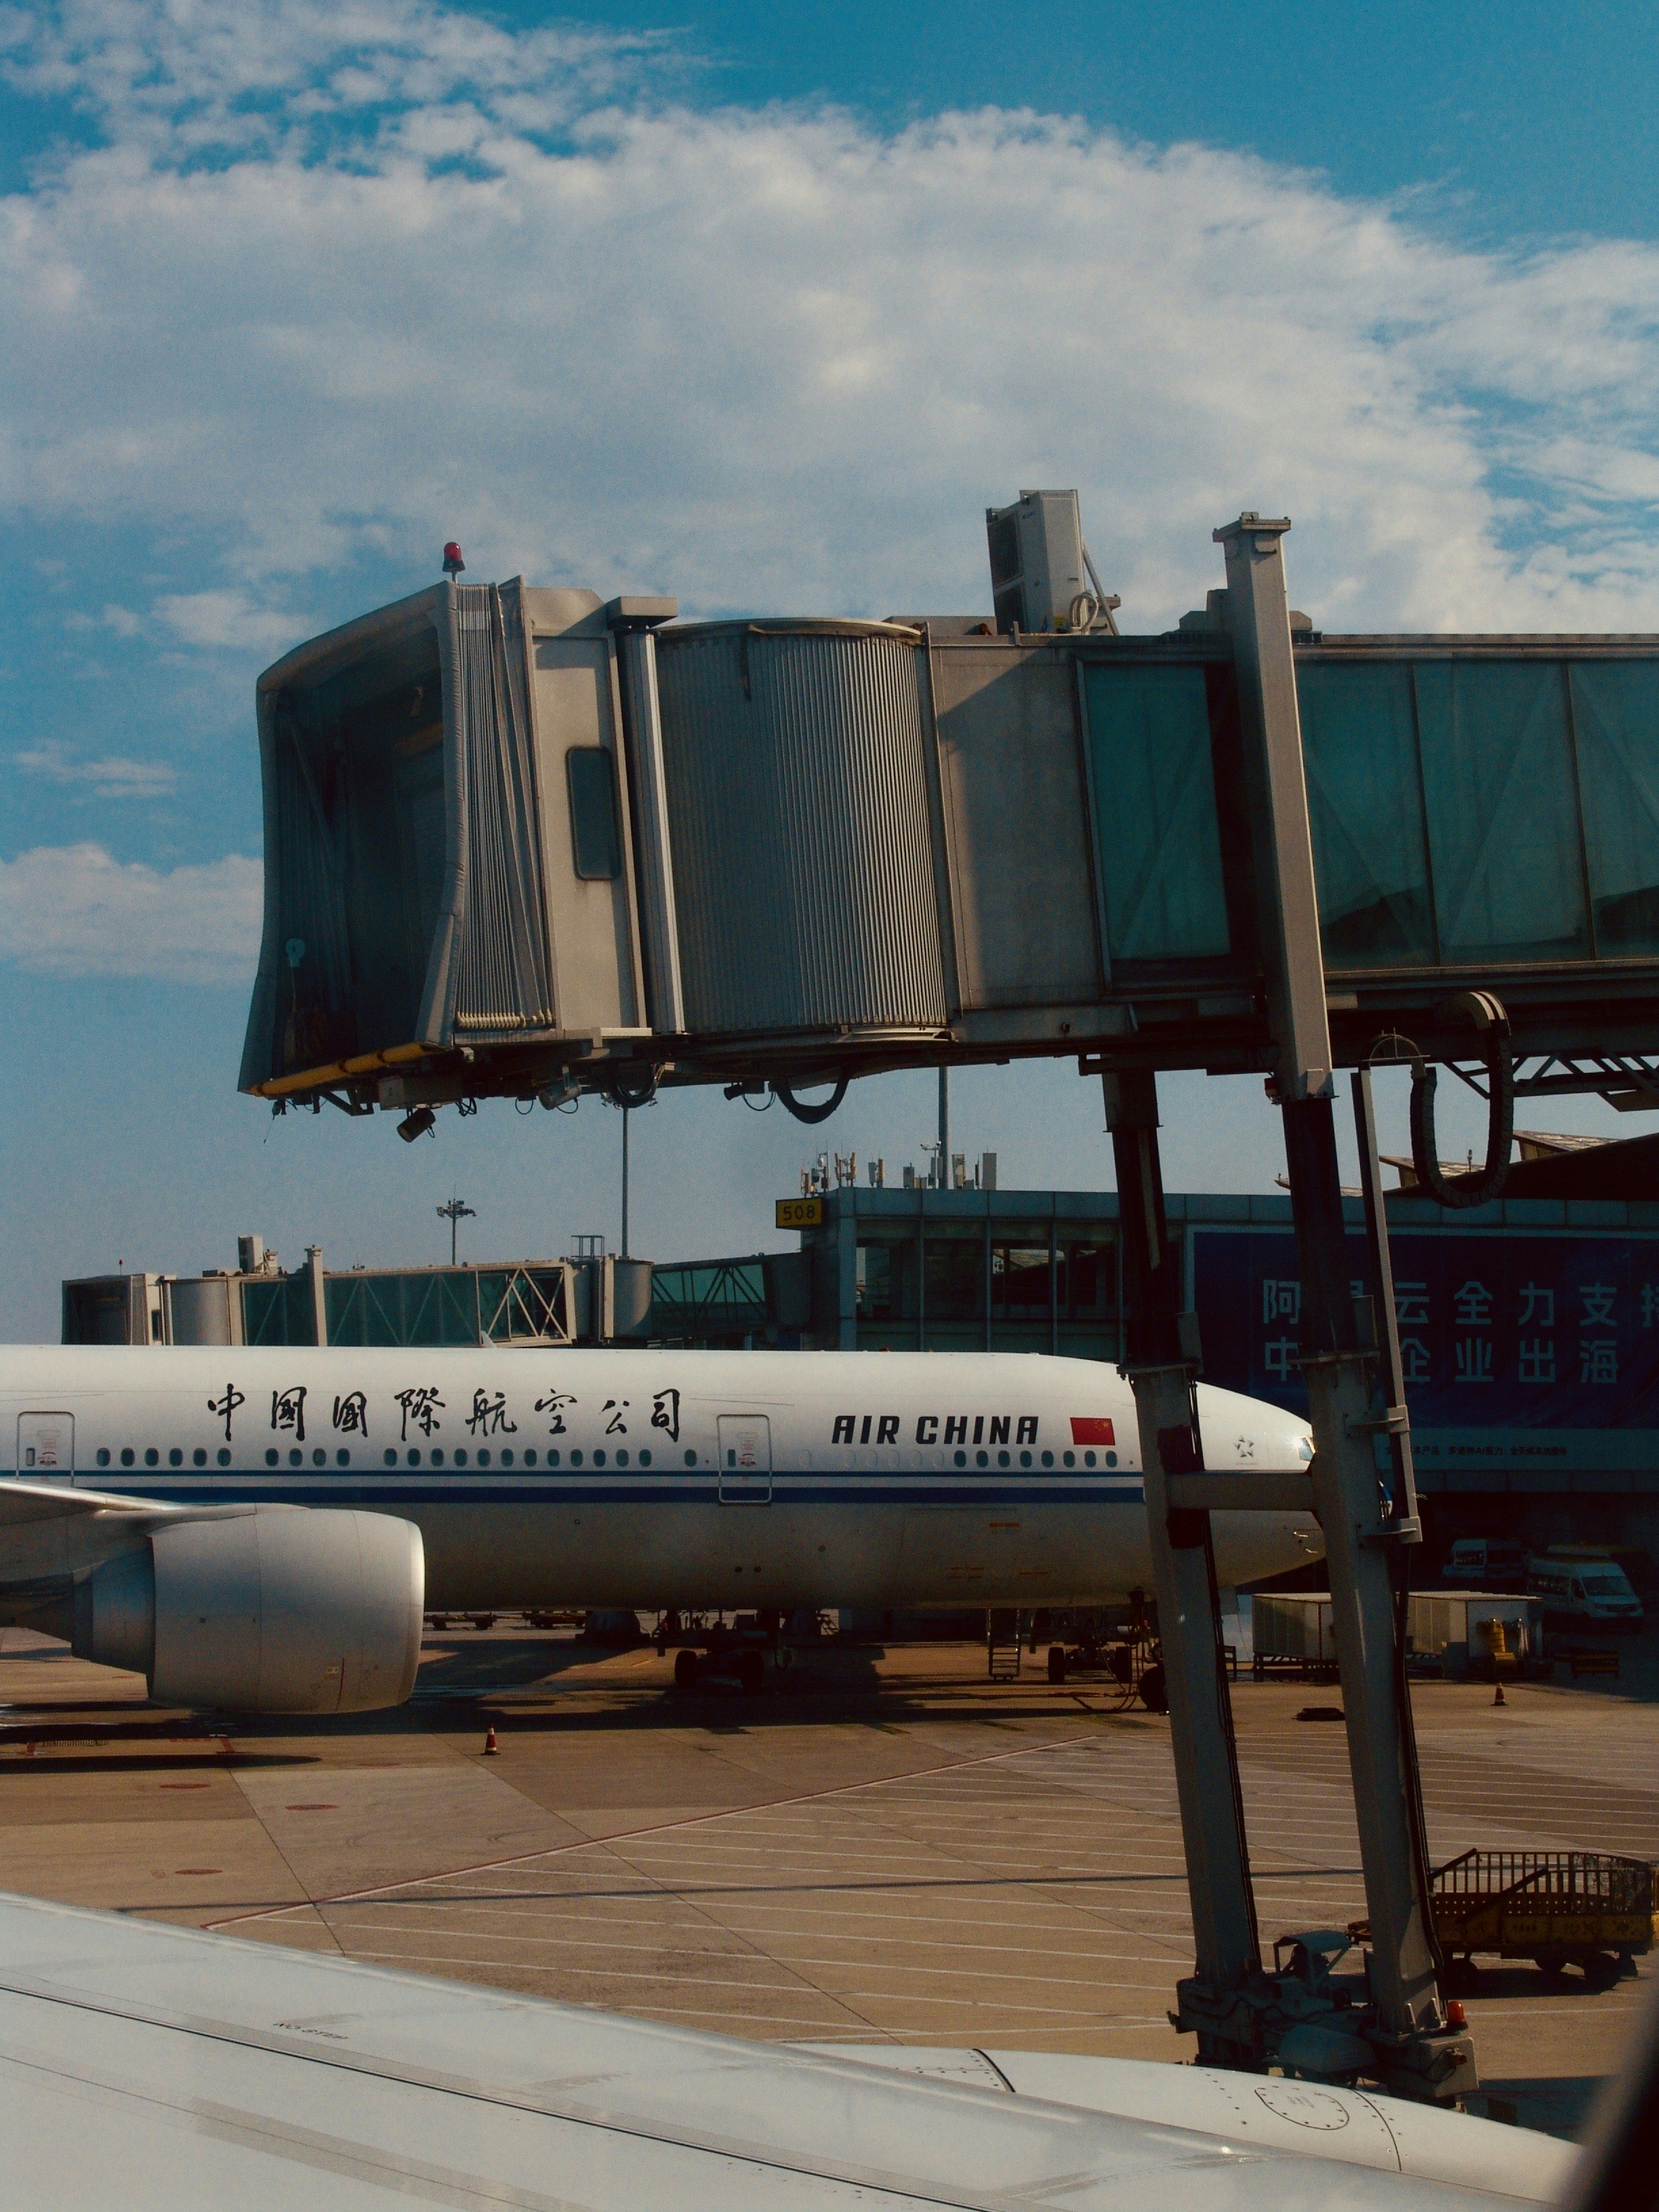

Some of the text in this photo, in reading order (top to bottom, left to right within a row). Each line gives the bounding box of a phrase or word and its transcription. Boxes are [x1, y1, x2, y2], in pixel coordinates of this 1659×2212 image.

[783, 1204, 815, 1221] 508
[1263, 1279, 1659, 1328] 阿云全力支
[1265, 1336, 1618, 1384] 中企业出海
[832, 1415, 1039, 1445] AIR CHINA
[302, 2029, 349, 2039] STEP
